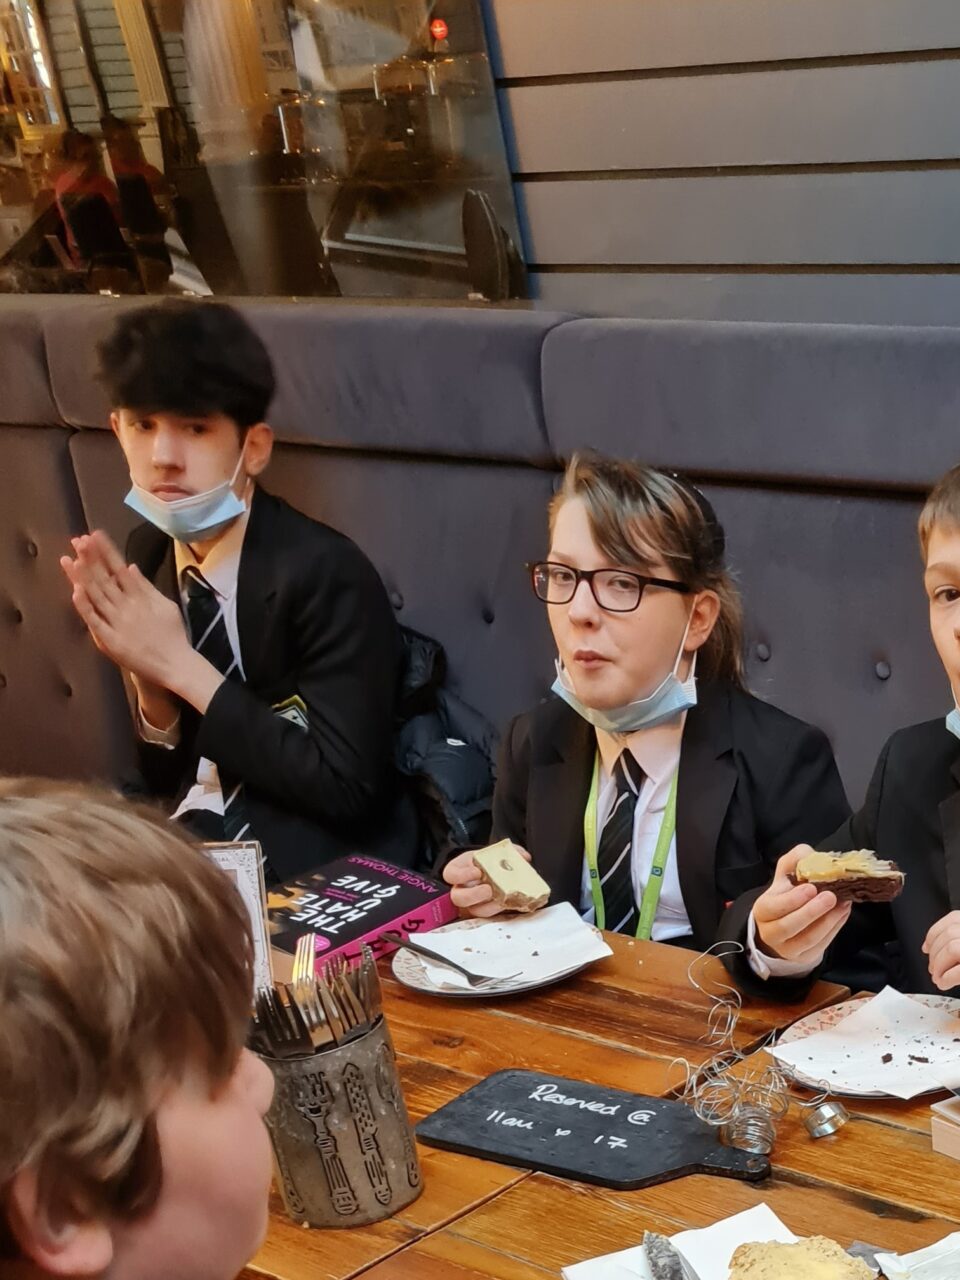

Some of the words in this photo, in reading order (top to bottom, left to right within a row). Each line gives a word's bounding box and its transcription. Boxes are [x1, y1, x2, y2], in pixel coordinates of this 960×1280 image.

[348, 856, 400, 879] THOMAS
[331, 875, 401, 899] GIVE
[399, 871, 440, 895] ANGIE
[291, 893, 367, 923] HATE
[362, 898, 383, 910] U
[289, 907, 346, 934] THE
[627, 1109, 657, 1125] @
